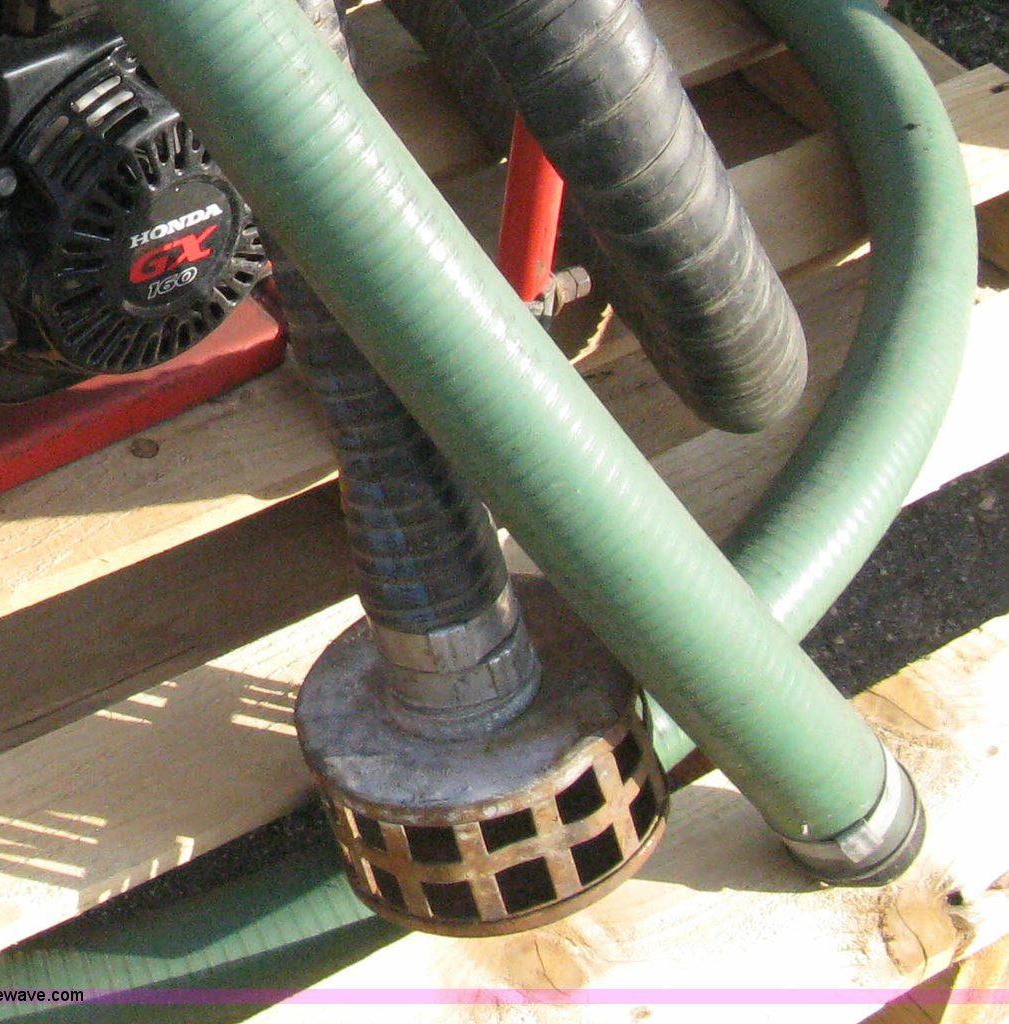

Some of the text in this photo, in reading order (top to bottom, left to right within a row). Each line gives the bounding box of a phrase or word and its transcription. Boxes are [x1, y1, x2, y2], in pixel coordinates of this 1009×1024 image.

[129, 203, 223, 249] HONDA
[129, 224, 218, 284] GX
[147, 266, 197, 300] 160
